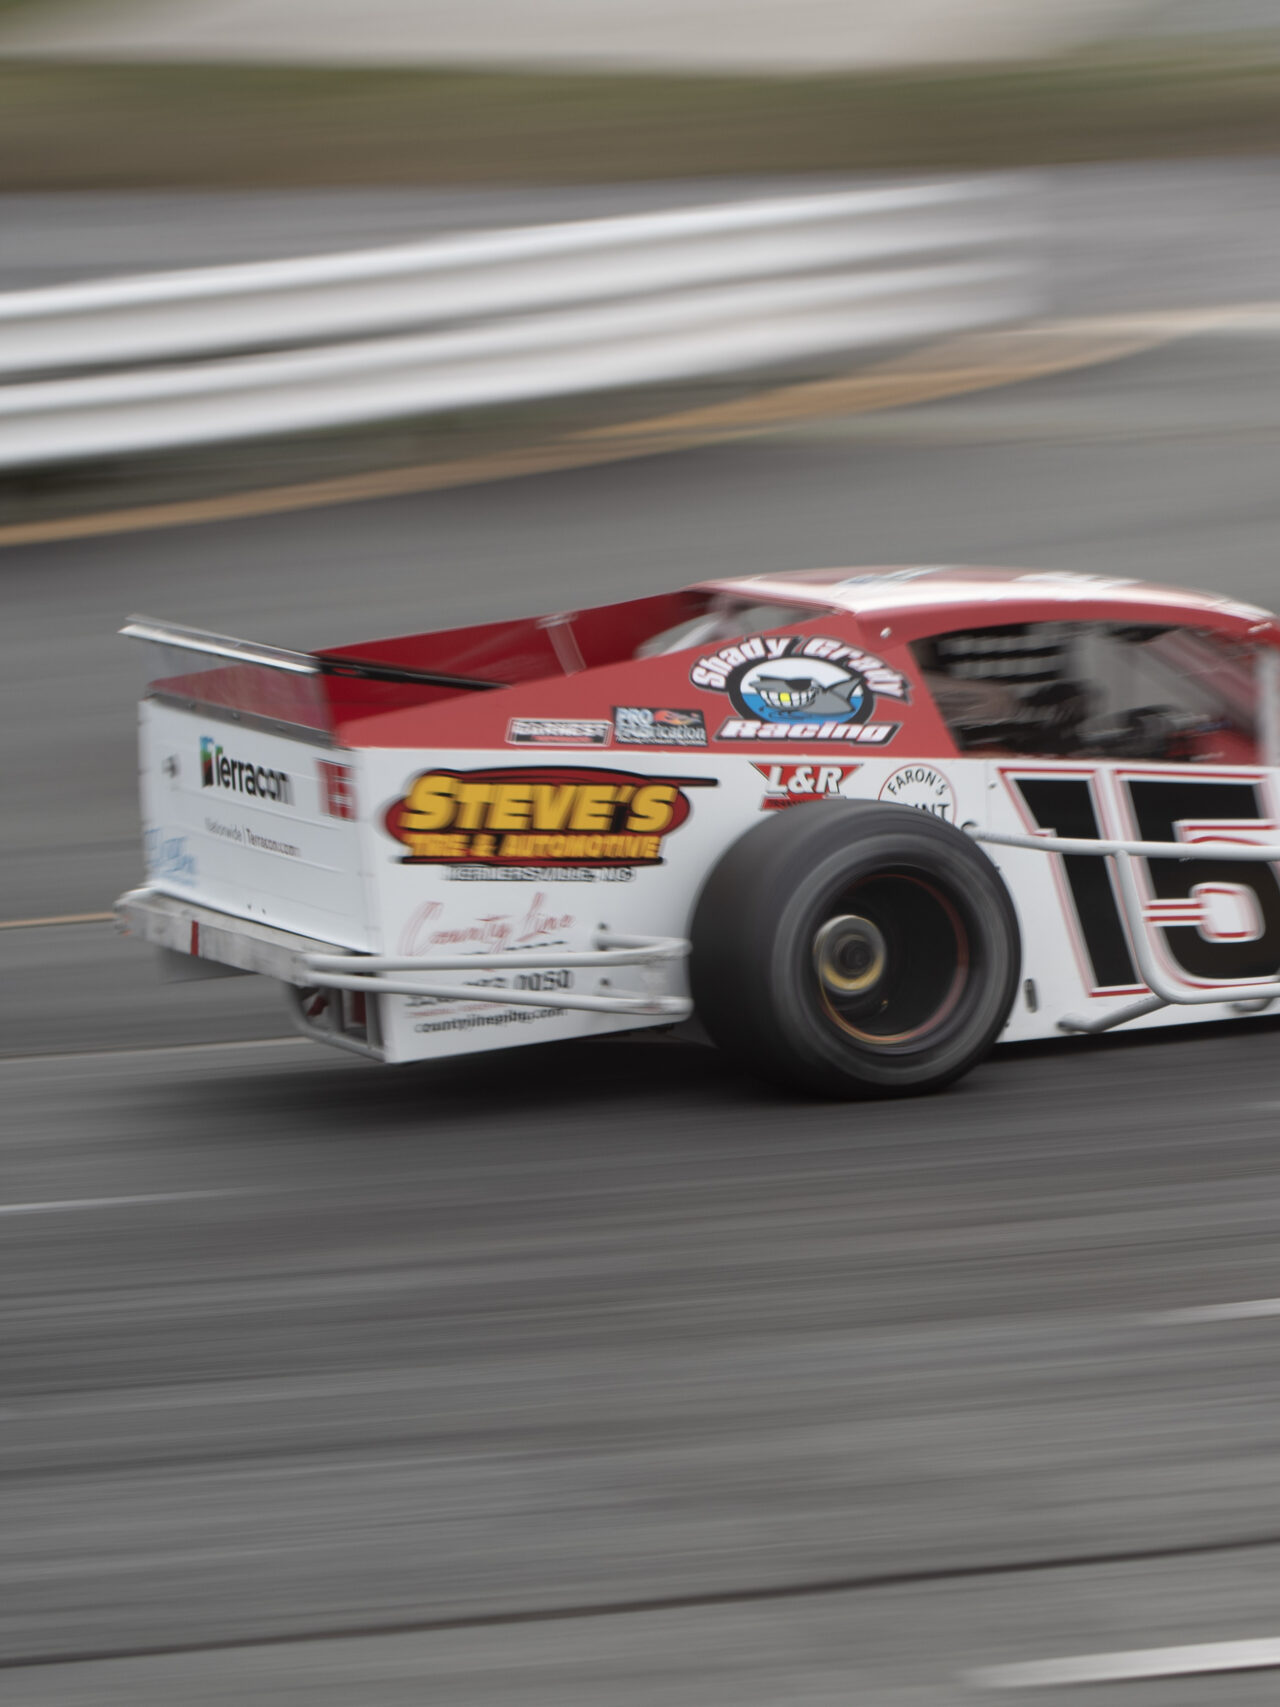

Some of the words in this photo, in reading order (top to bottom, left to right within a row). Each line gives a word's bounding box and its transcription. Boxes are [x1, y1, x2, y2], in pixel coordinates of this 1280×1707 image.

[691, 636, 792, 689] Shady
[803, 637, 904, 698] Grady
[720, 719, 894, 742] Racing
[200, 736, 295, 805] Terracon
[767, 766, 843, 794] L&R
[887, 768, 950, 796] FARON'S
[400, 775, 681, 833] STEVE'S
